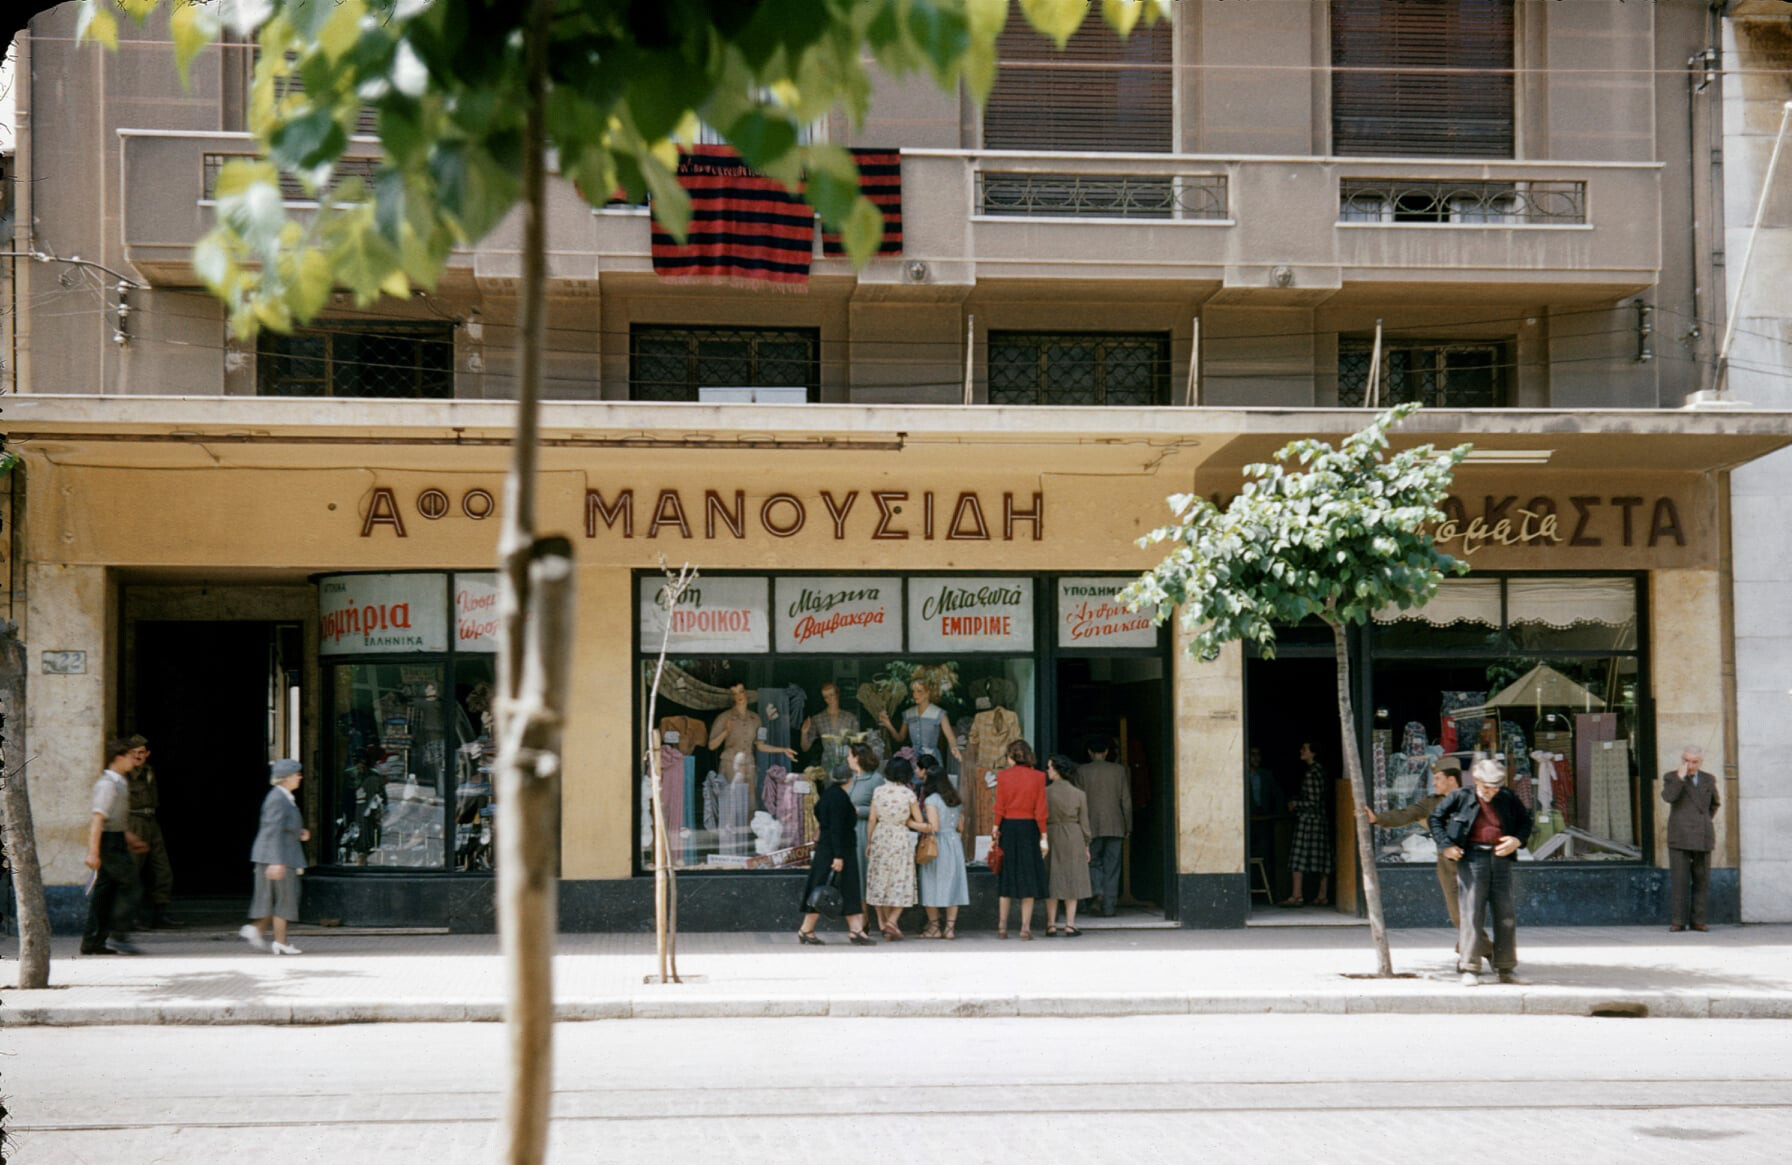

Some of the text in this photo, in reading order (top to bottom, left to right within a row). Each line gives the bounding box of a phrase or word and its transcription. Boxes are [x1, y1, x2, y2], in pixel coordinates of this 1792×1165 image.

[360, 487, 1043, 541] ΑΦΟ ΜΑΝΟΥΣΙΔΗ
[1435, 495, 1687, 547] ΑΚΩΣΤΑ
[672, 609, 751, 633] ΠΡΟΙΚΟΣ
[922, 584, 1022, 621] Μεταξωτά
[942, 615, 1011, 636] ΕΜΠΡΙΜΕ
